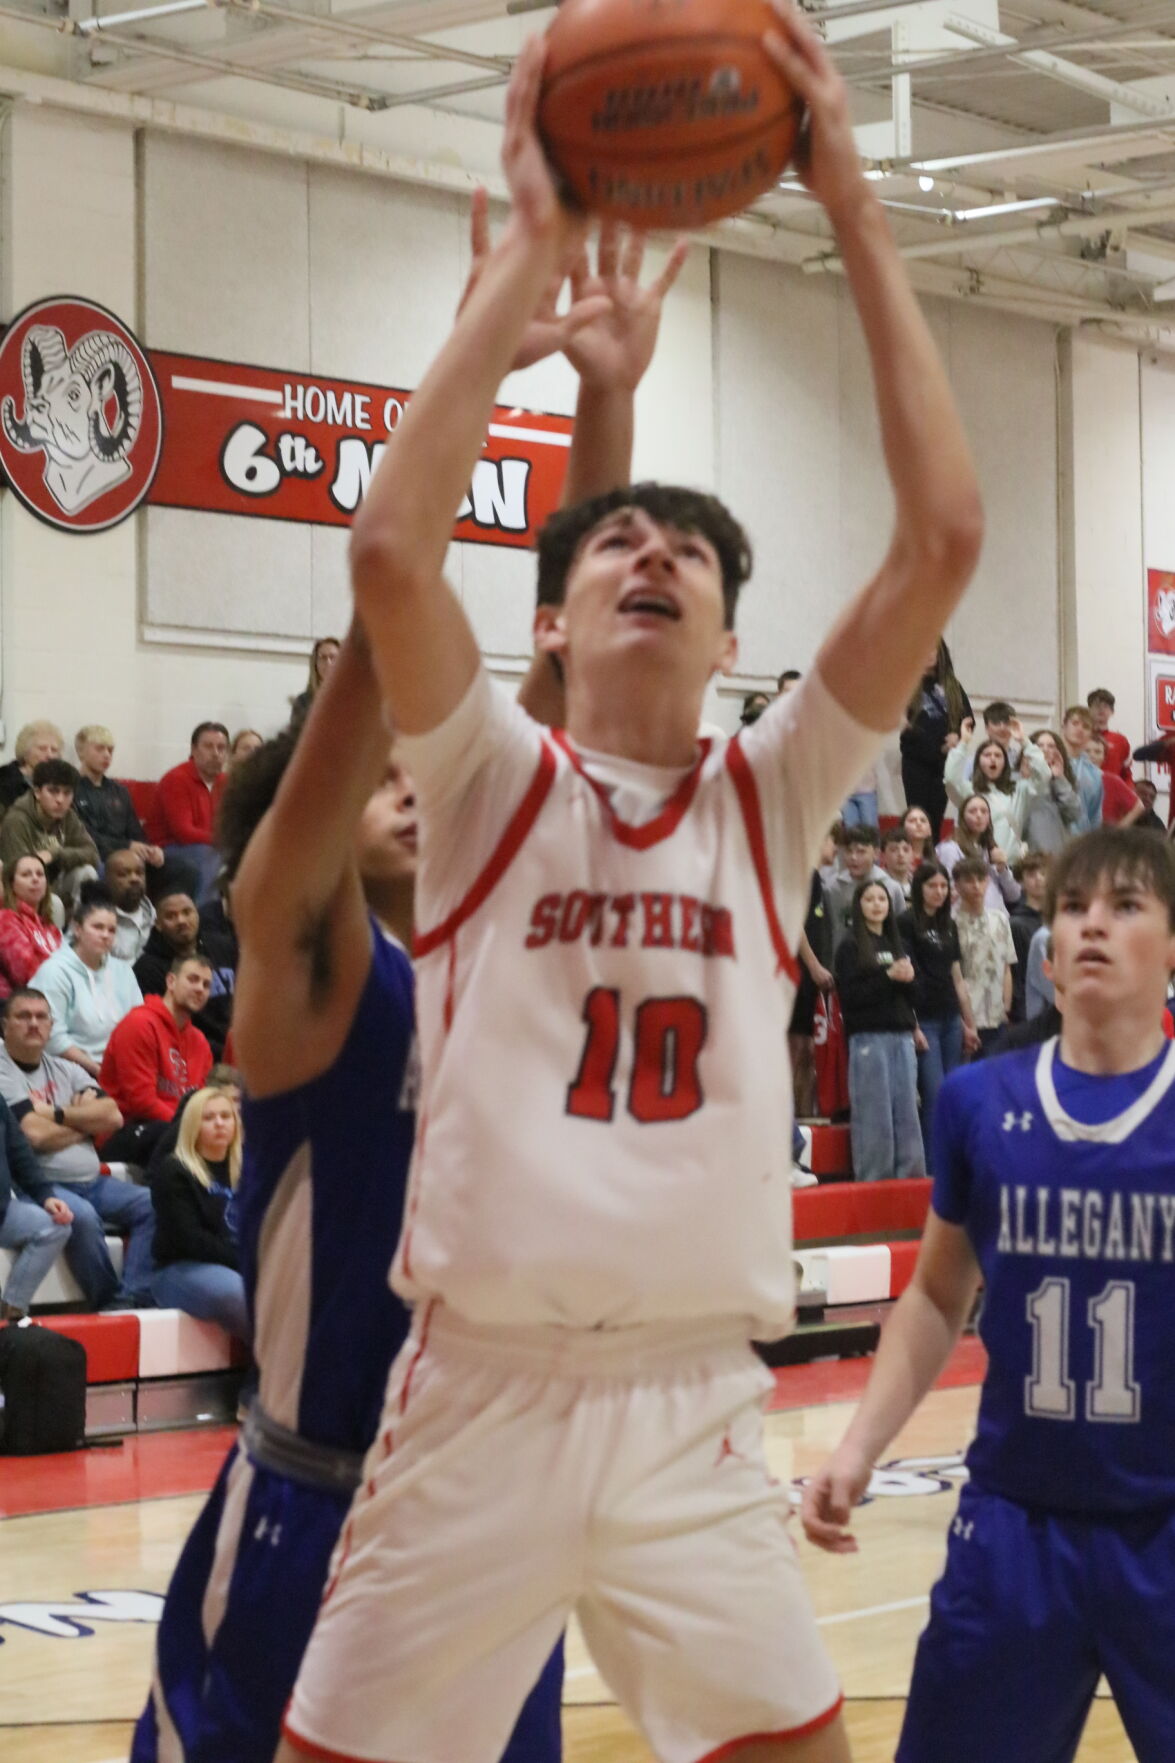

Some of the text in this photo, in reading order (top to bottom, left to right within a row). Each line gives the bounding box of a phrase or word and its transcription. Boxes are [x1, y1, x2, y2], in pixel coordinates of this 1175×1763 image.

[283, 383, 408, 433] HOME O
[221, 420, 531, 533] 6th MN
[566, 985, 708, 1124] 10
[998, 1183, 1175, 1263] ALLEGANY
[1025, 1276, 1141, 1424] 11
